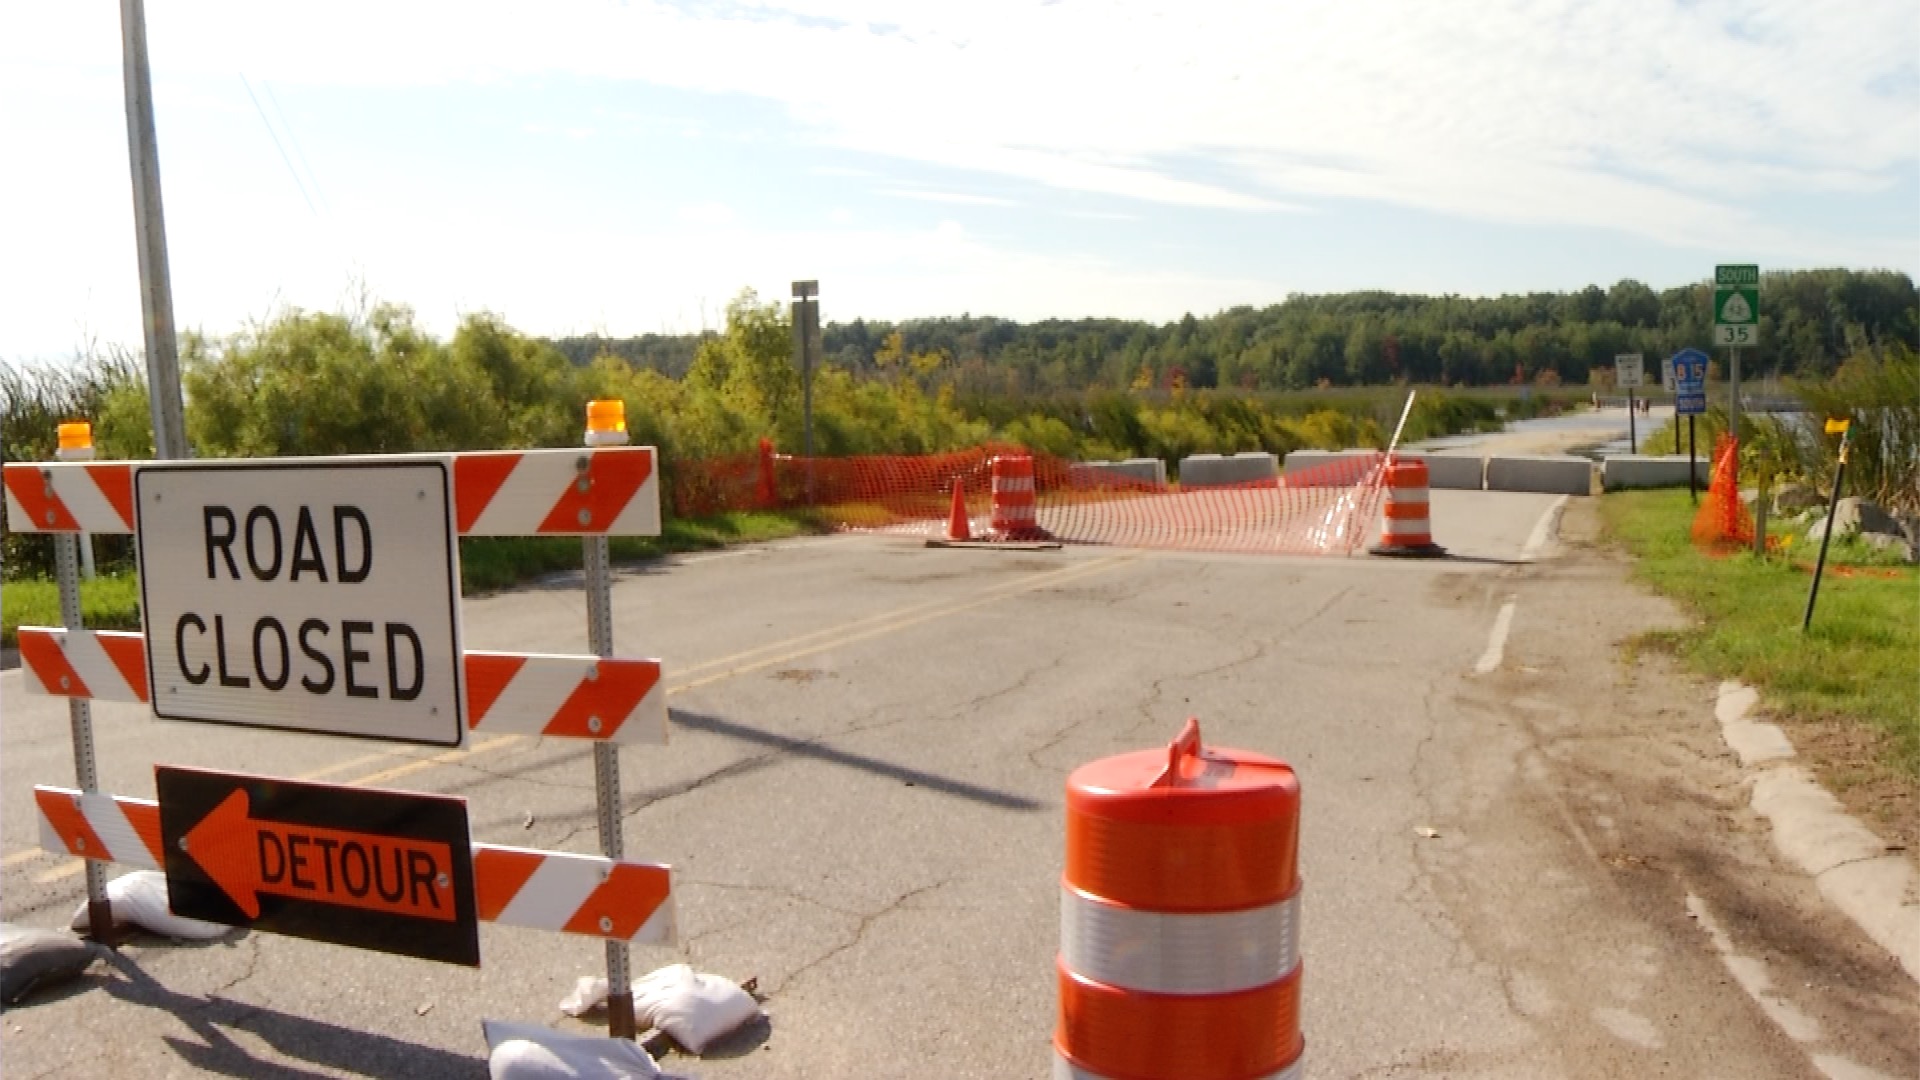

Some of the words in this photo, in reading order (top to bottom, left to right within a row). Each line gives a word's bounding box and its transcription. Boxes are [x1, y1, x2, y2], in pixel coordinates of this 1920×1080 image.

[1717, 267, 1756, 282] SOUTH
[1723, 327, 1749, 343] 35
[203, 504, 372, 583] ROAD
[175, 611, 425, 701] CLOSED
[257, 829, 441, 909] DETOUR
